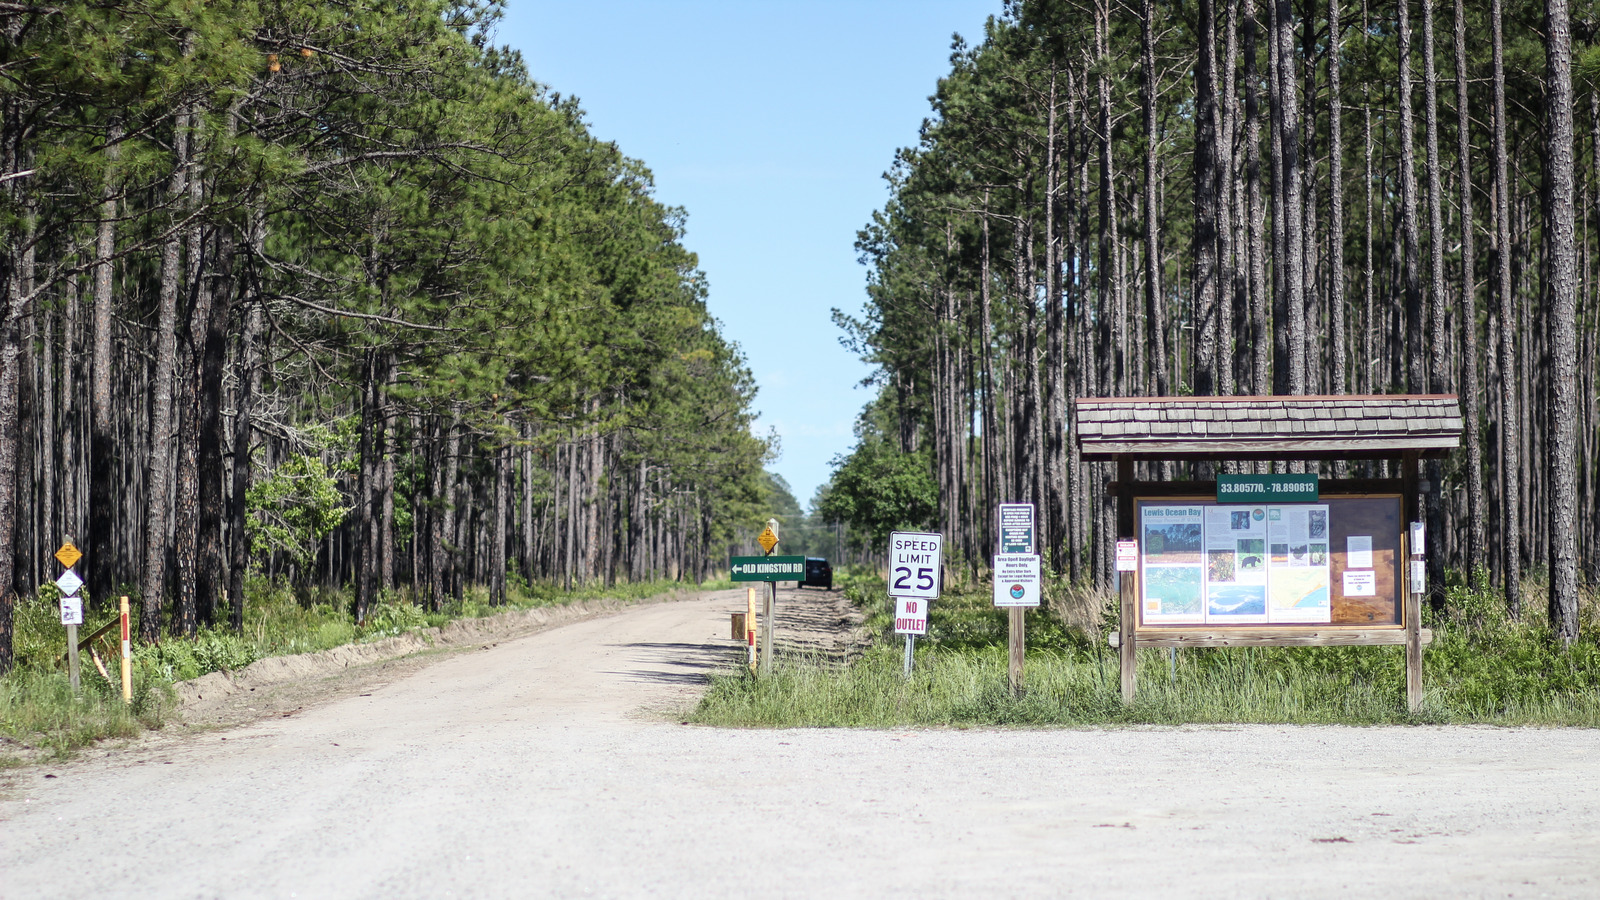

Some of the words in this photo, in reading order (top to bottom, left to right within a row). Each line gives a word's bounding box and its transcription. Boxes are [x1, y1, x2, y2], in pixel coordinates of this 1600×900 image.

[1221, 483, 1266, 494] 33.805770,
[1271, 482, 1314, 493] 78.890813
[1188, 508, 1201, 517] Bay
[895, 540, 937, 551] SPEED
[899, 554, 931, 564] LIMIT
[742, 563, 756, 574] OLD
[757, 563, 792, 574] KINGSTON
[793, 563, 803, 573] RD
[894, 566, 934, 590] 25
[906, 602, 917, 614] NO
[896, 618, 926, 630] OUTLET
